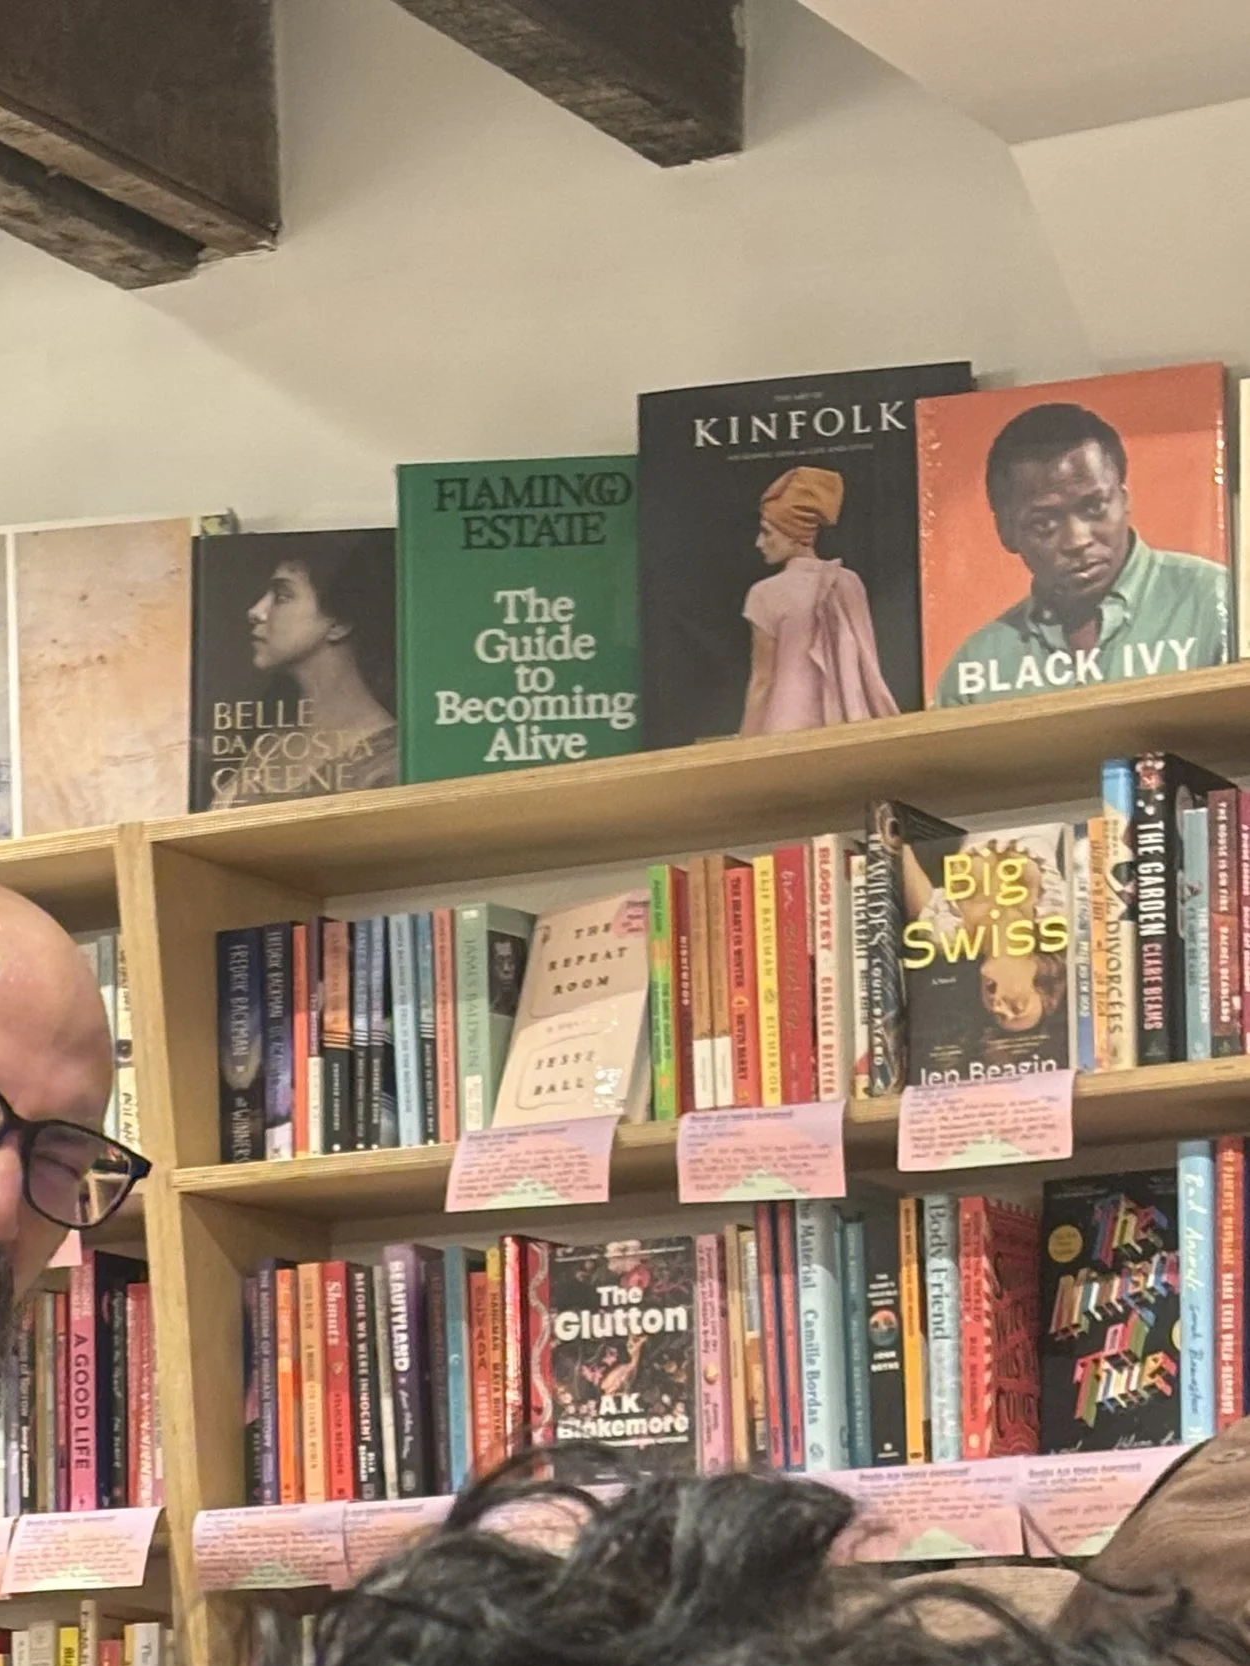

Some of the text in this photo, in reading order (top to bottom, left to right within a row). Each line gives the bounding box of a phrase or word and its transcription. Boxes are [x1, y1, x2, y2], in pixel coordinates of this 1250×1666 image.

[693, 401, 907, 447] KINFOLK
[434, 472, 633, 512] FLAMINGO
[462, 512, 607, 550] ESTATE
[494, 587, 575, 624] The
[474, 624, 597, 663] Guide
[958, 637, 1196, 695] BLACK IVY
[434, 684, 638, 730] Becoming
[514, 664, 555, 693] to
[214, 699, 315, 730] BELLE
[483, 724, 588, 762] Alive
[212, 731, 374, 761] DA COSTA
[211, 763, 354, 795] GREENE
[943, 848, 1030, 906] Big
[1136, 820, 1167, 937] THE GARDEN
[1217, 802, 1230, 911] THE HOUSE IS ON FIRE
[818, 846, 833, 951] BLOOD TEST
[868, 861, 889, 947] WILDES
[547, 946, 629, 972] REPEAT
[574, 922, 613, 940] THE
[761, 907, 774, 977] BATUMAN
[902, 909, 1070, 970] Swiss
[1219, 926, 1230, 965] RACHEL
[228, 943, 250, 1057] FREDRIK BACKMAN
[269, 972, 283, 1018] BACKMAN
[553, 975, 610, 995] ROOM
[1105, 920, 1124, 1034] DIVORCÉES
[1142, 943, 1163, 1031] CLARE BEAMS
[873, 1007, 883, 1067] BAYARD
[799, 1201, 816, 1289] he Material
[929, 1203, 948, 1260] Body
[1185, 1226, 1206, 1291] Animals
[388, 1260, 410, 1372] BEAUTYLAND
[554, 1304, 688, 1342] Glutton
[596, 1286, 643, 1307] The
[931, 1266, 951, 1341] Friend
[354, 1272, 371, 1442] BEFORE WE WERE INNOCENT
[803, 1309, 822, 1425] Camille Bordas
[74, 1333, 91, 1469] A GOOD LIFE
